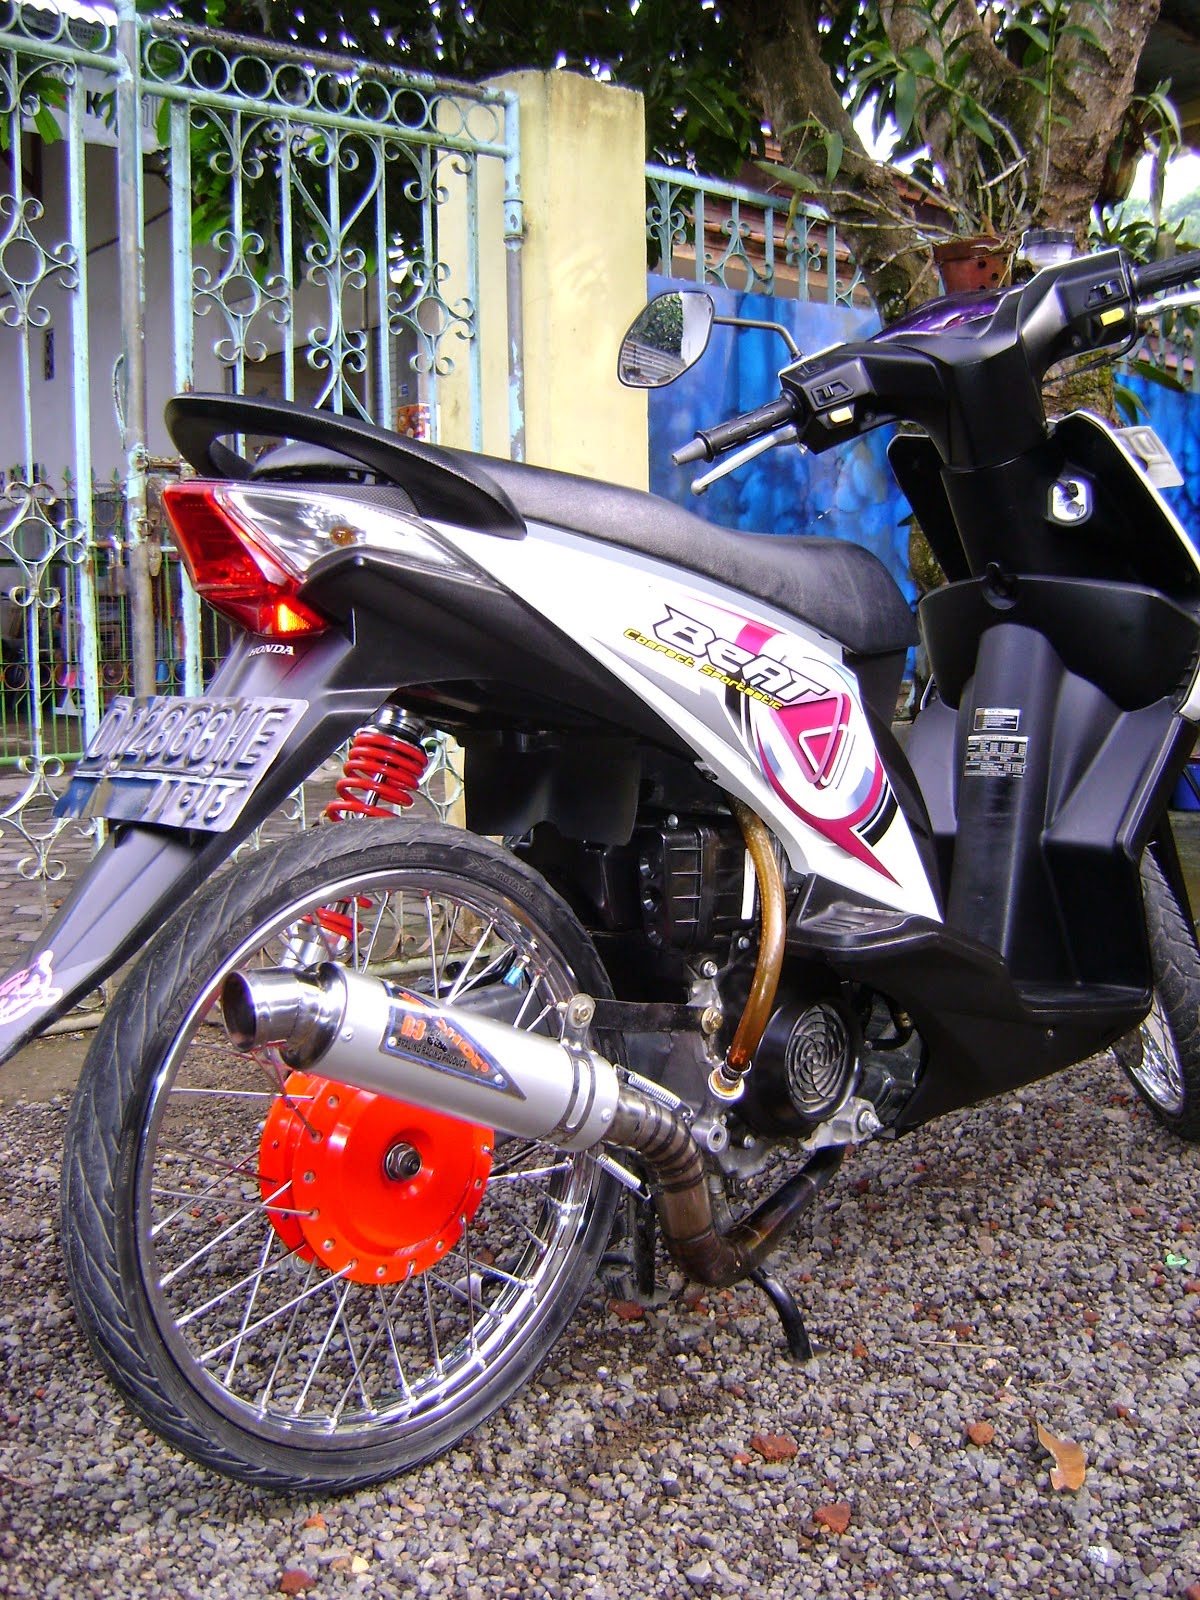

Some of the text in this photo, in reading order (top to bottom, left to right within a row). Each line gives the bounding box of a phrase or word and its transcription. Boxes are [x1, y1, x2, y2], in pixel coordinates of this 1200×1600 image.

[248, 644, 294, 657] HONDA
[623, 628, 784, 711] Compact Sportmatic
[497, 872, 537, 903] ROTATION
[421, 1044, 440, 1061] RACING
[440, 1051, 468, 1069] PRODUCT
